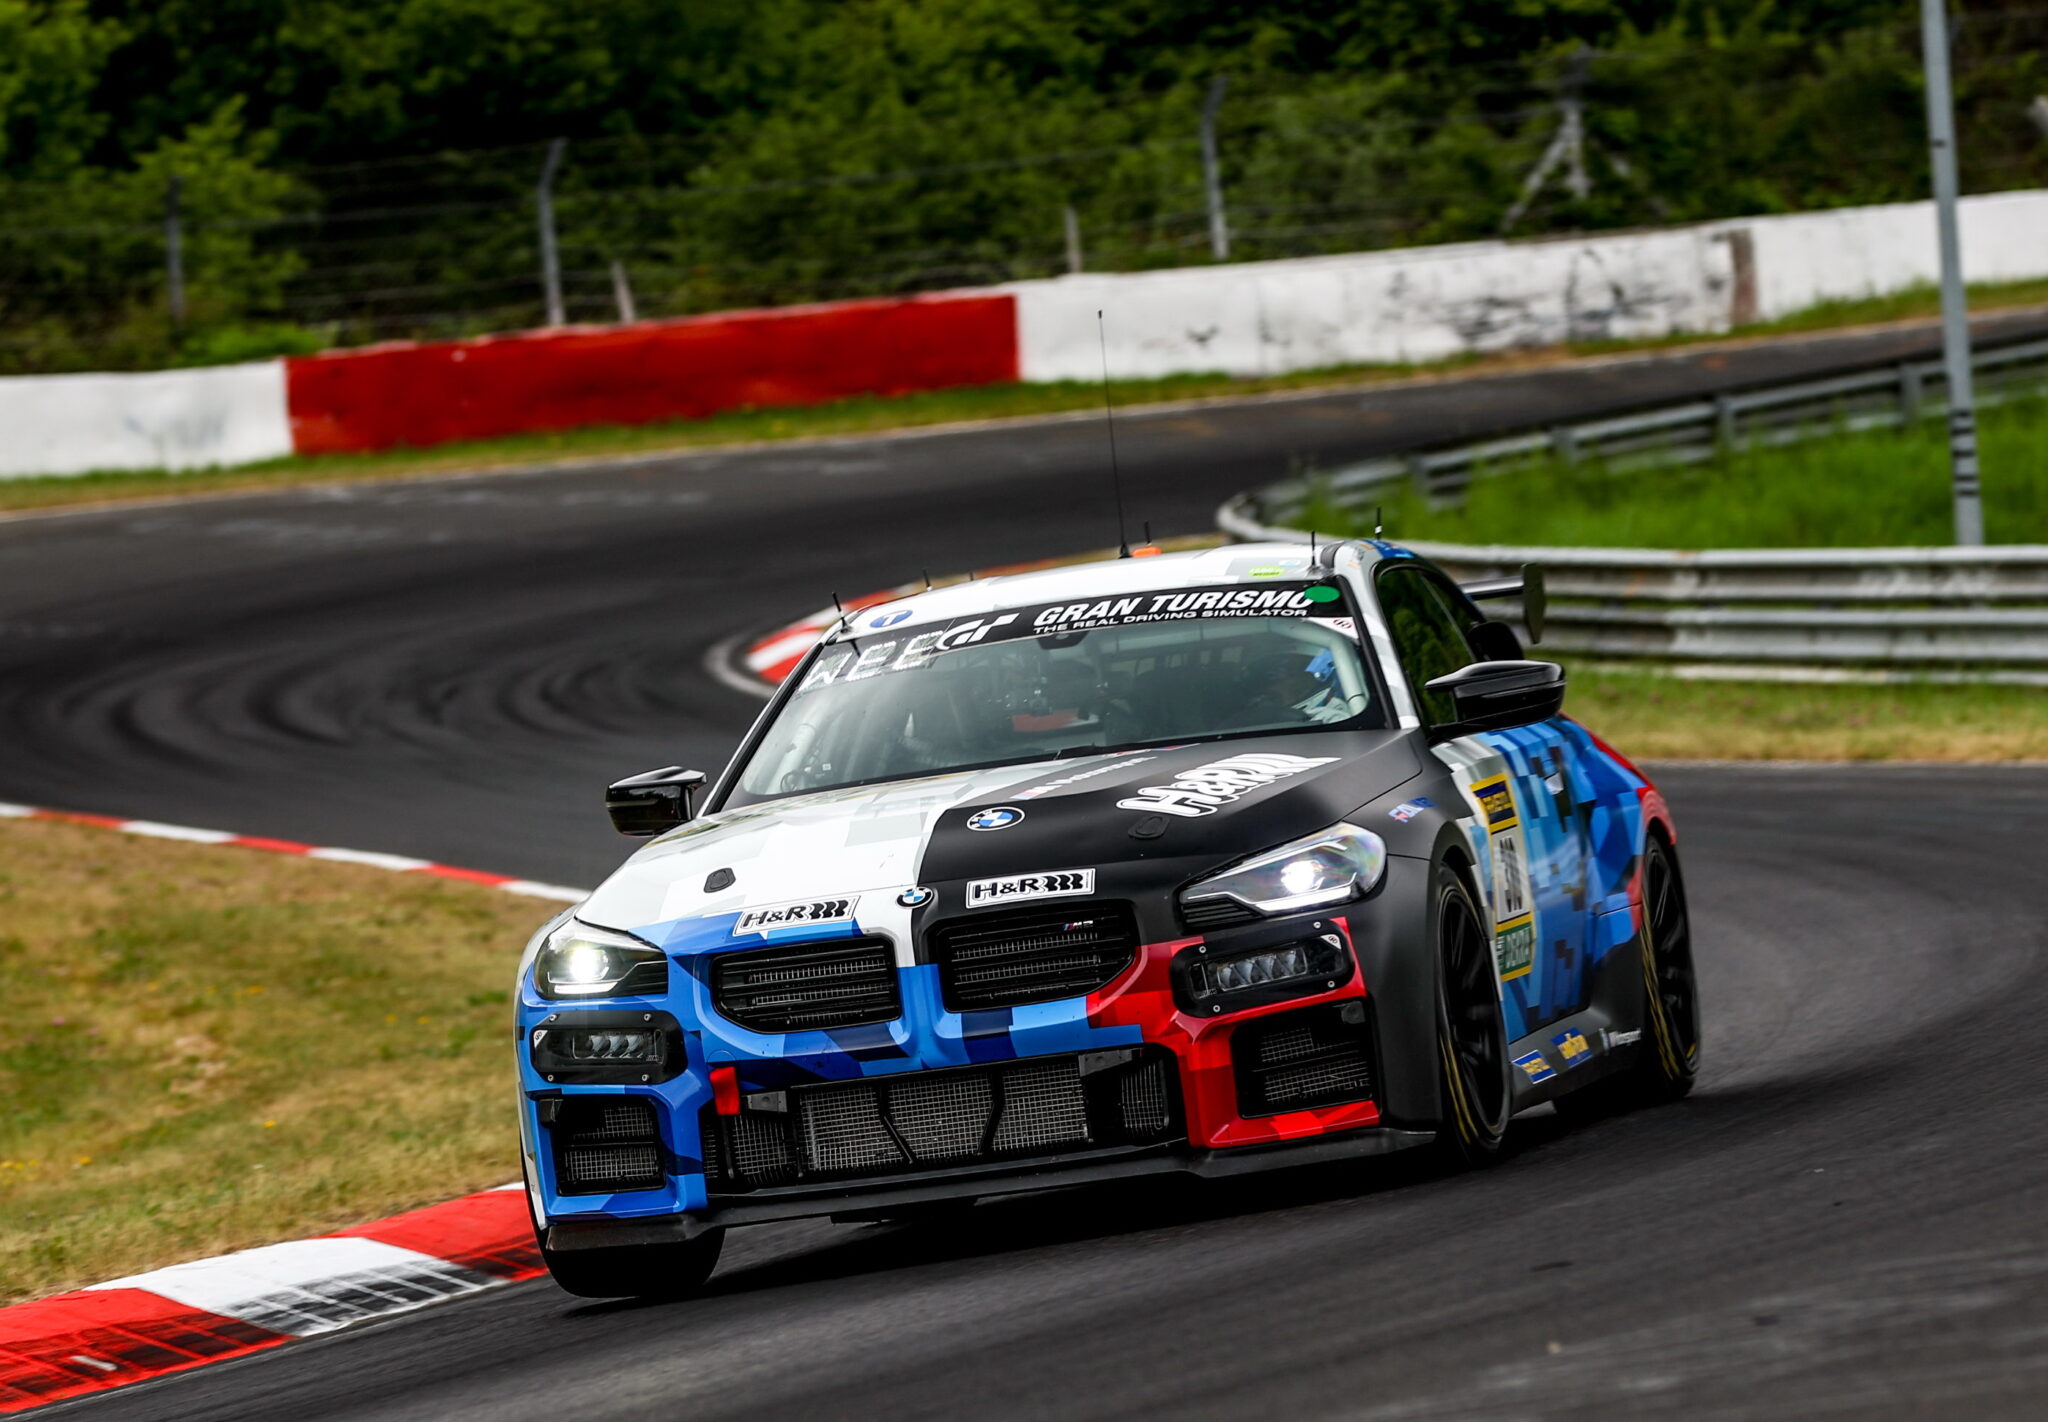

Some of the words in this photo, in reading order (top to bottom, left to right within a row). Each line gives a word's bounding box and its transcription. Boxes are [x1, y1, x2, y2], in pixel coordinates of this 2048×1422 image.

[1033, 597, 1142, 627] GRAN
[1148, 589, 1317, 614] TURISMO
[1033, 623, 1068, 635] THE
[1073, 618, 1118, 631] REAL
[1124, 611, 1199, 625] DRIVING
[1202, 607, 1308, 619] SIMULATOR
[1117, 766, 1282, 817] H&R
[974, 878, 1040, 899] H&R
[742, 905, 807, 928] H&R
